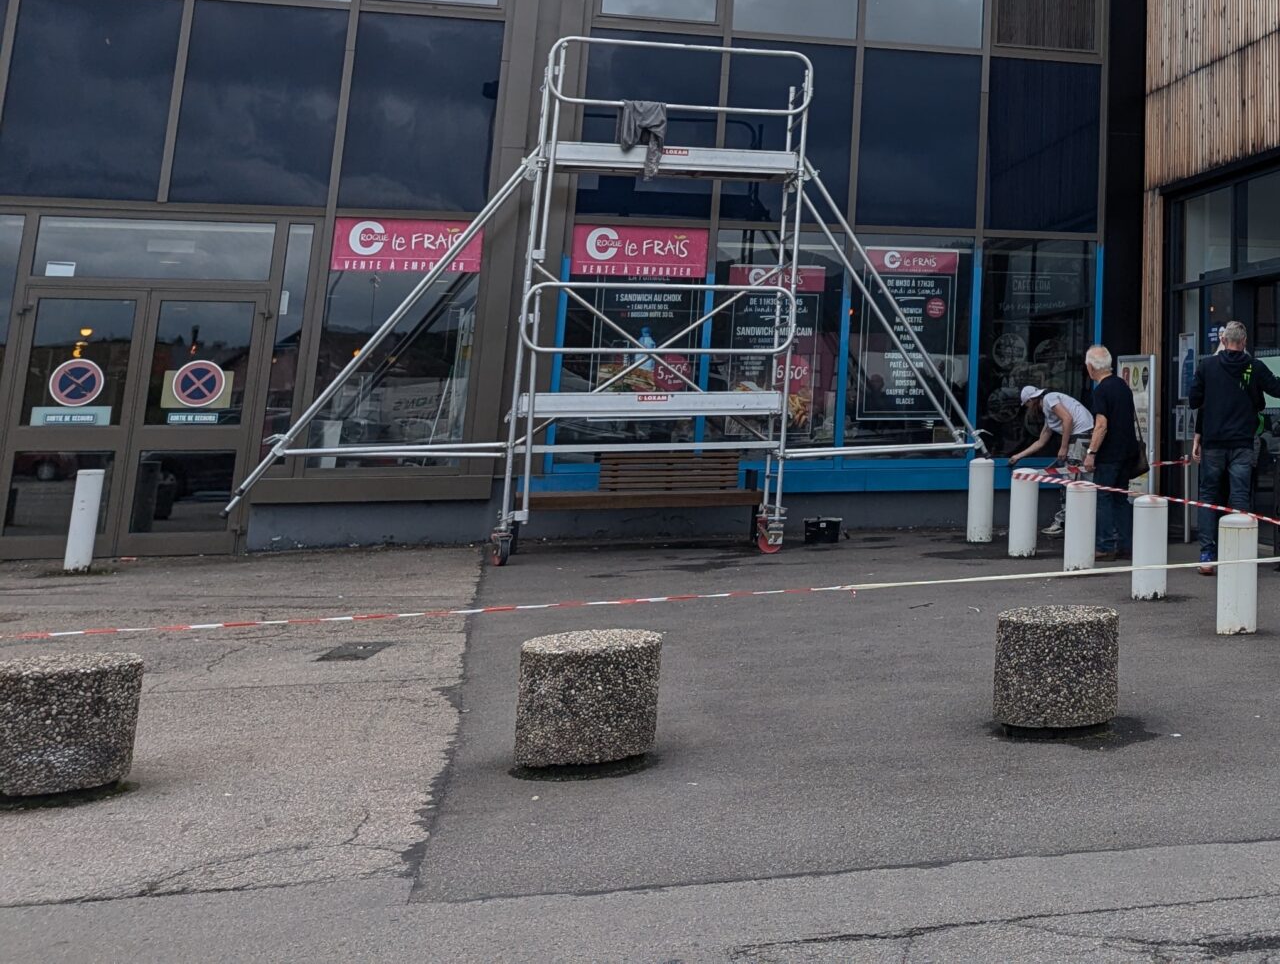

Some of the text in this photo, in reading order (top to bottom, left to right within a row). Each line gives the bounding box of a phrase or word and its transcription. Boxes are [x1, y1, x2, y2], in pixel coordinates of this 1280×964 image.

[344, 258, 465, 271] VENTE À EMPOER
[582, 263, 691, 276] VENTE À EMPORTER
[620, 294, 653, 302] SANDWICH
[663, 294, 682, 302] CHOIX
[736, 326, 774, 336] SANDWICH
